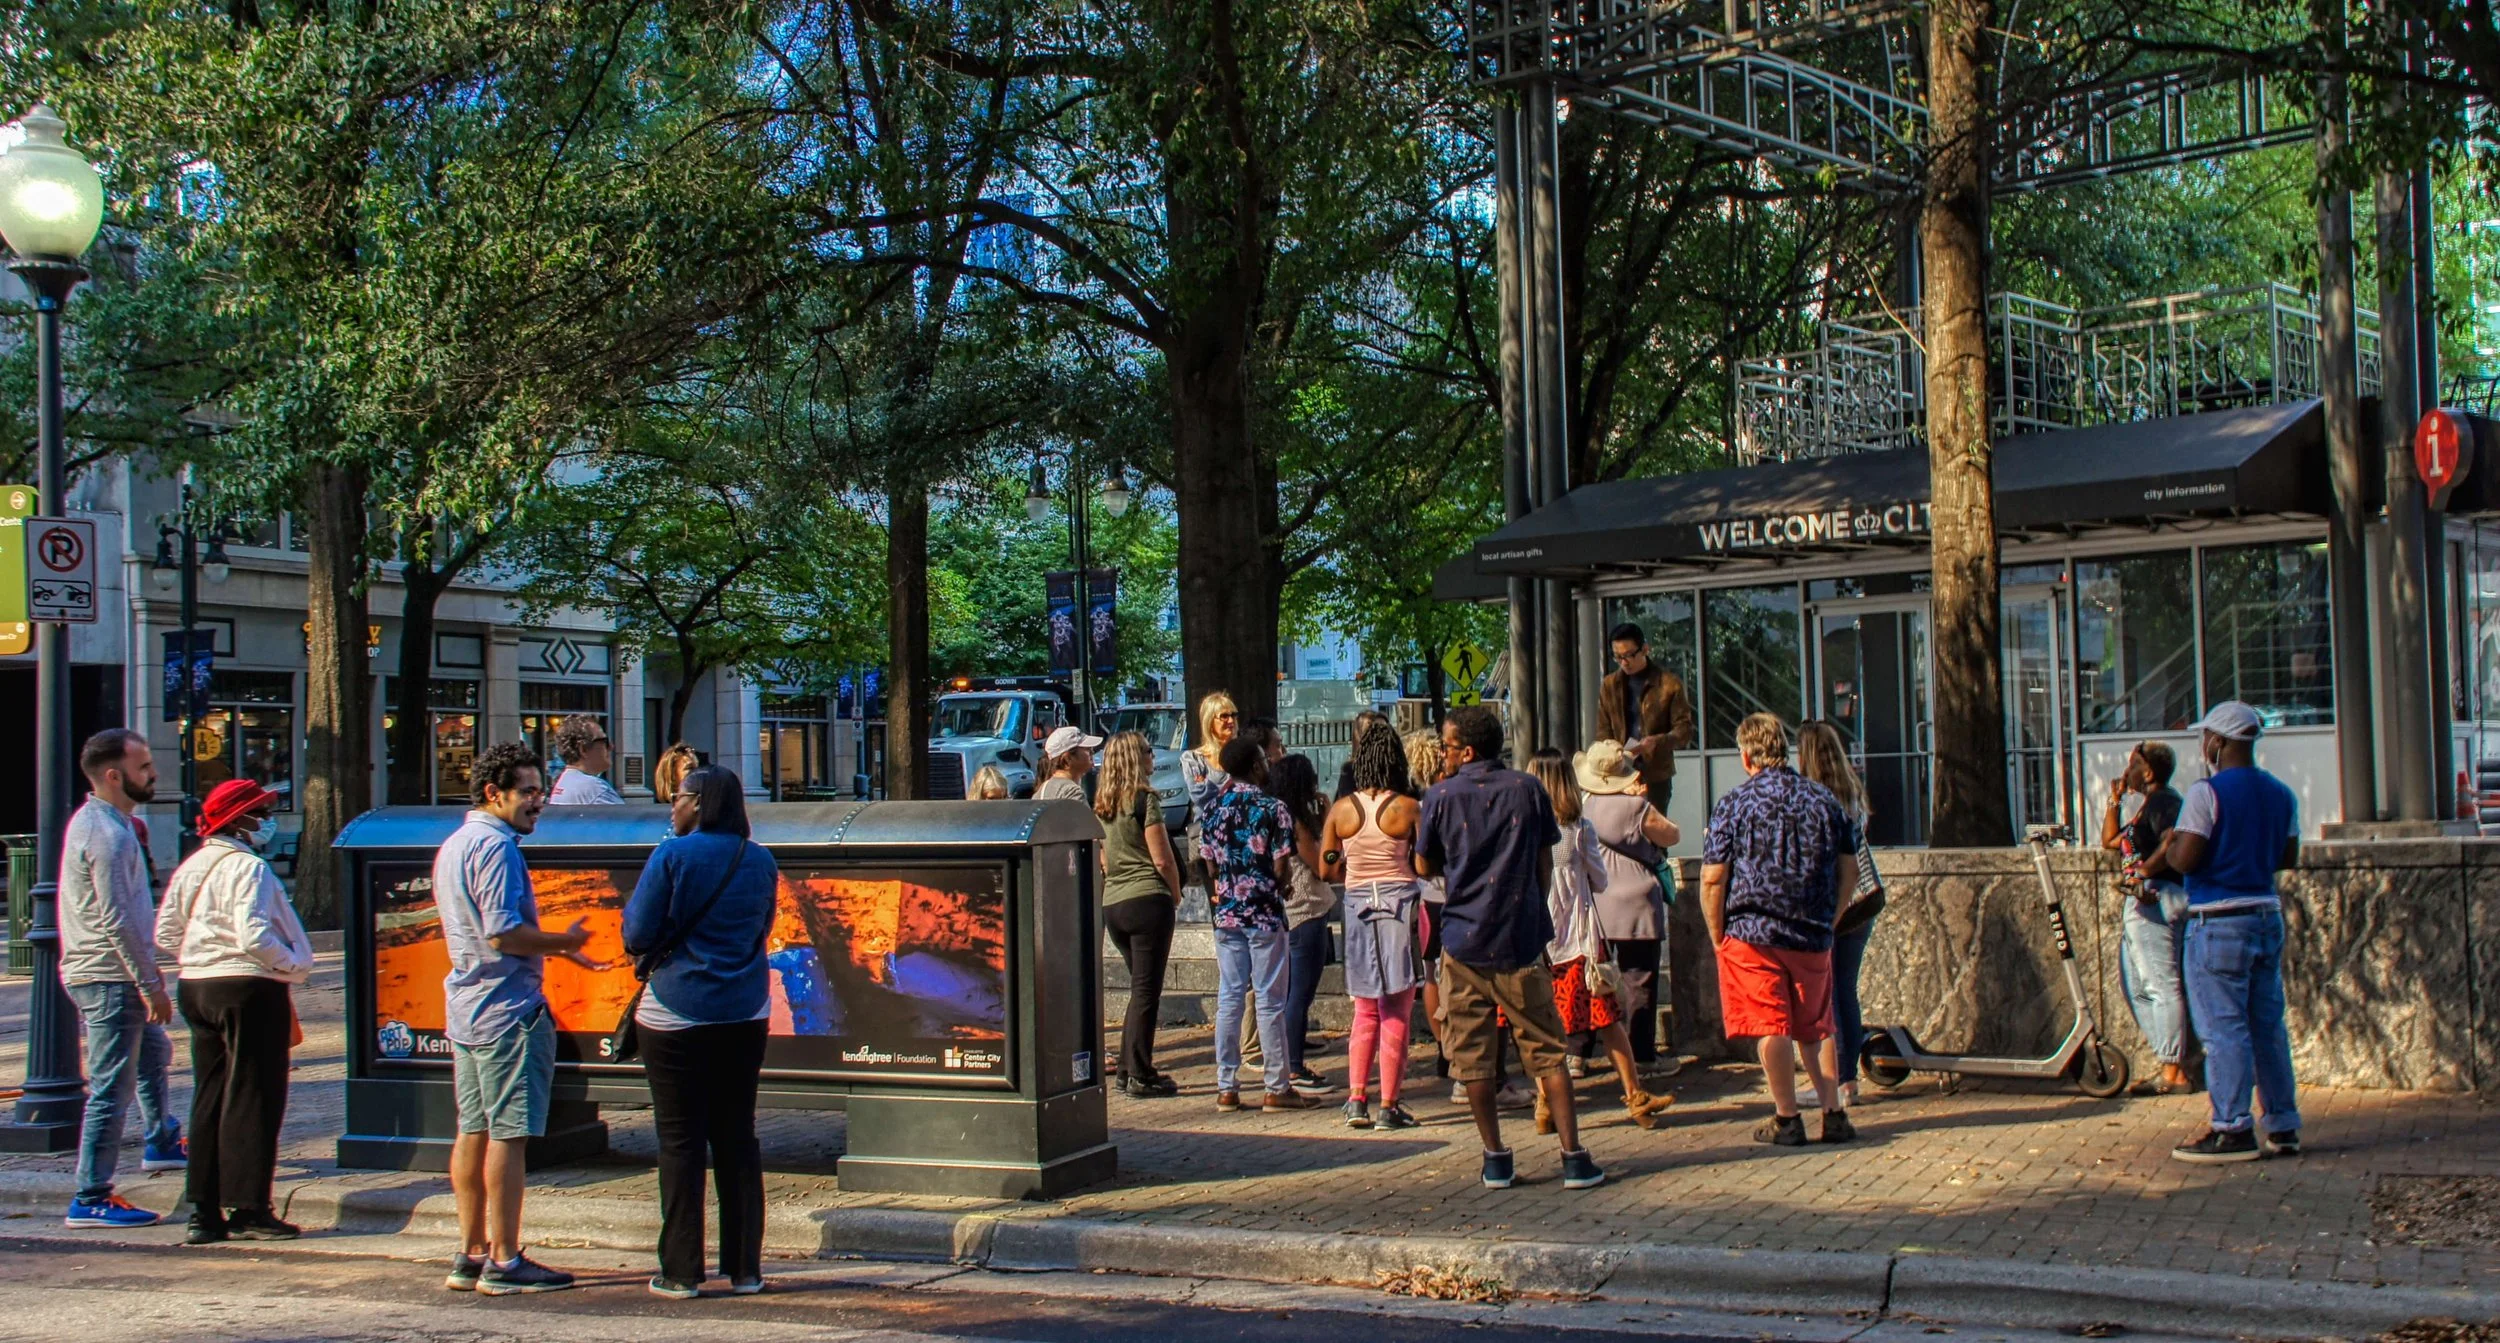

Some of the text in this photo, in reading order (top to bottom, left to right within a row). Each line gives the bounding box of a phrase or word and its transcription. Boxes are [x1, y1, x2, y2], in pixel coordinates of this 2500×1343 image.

[2144, 483, 2226, 501] city information
[1699, 510, 1850, 551] WELCOME
[1481, 548, 1543, 561] local artisan gifts
[2049, 911, 2069, 951] BIRD
[380, 1026, 403, 1041] ART
[842, 1045, 937, 1065] lendingtree Foundation
[963, 1053, 1002, 1063] Center City
[963, 1060, 992, 1069] Partners
